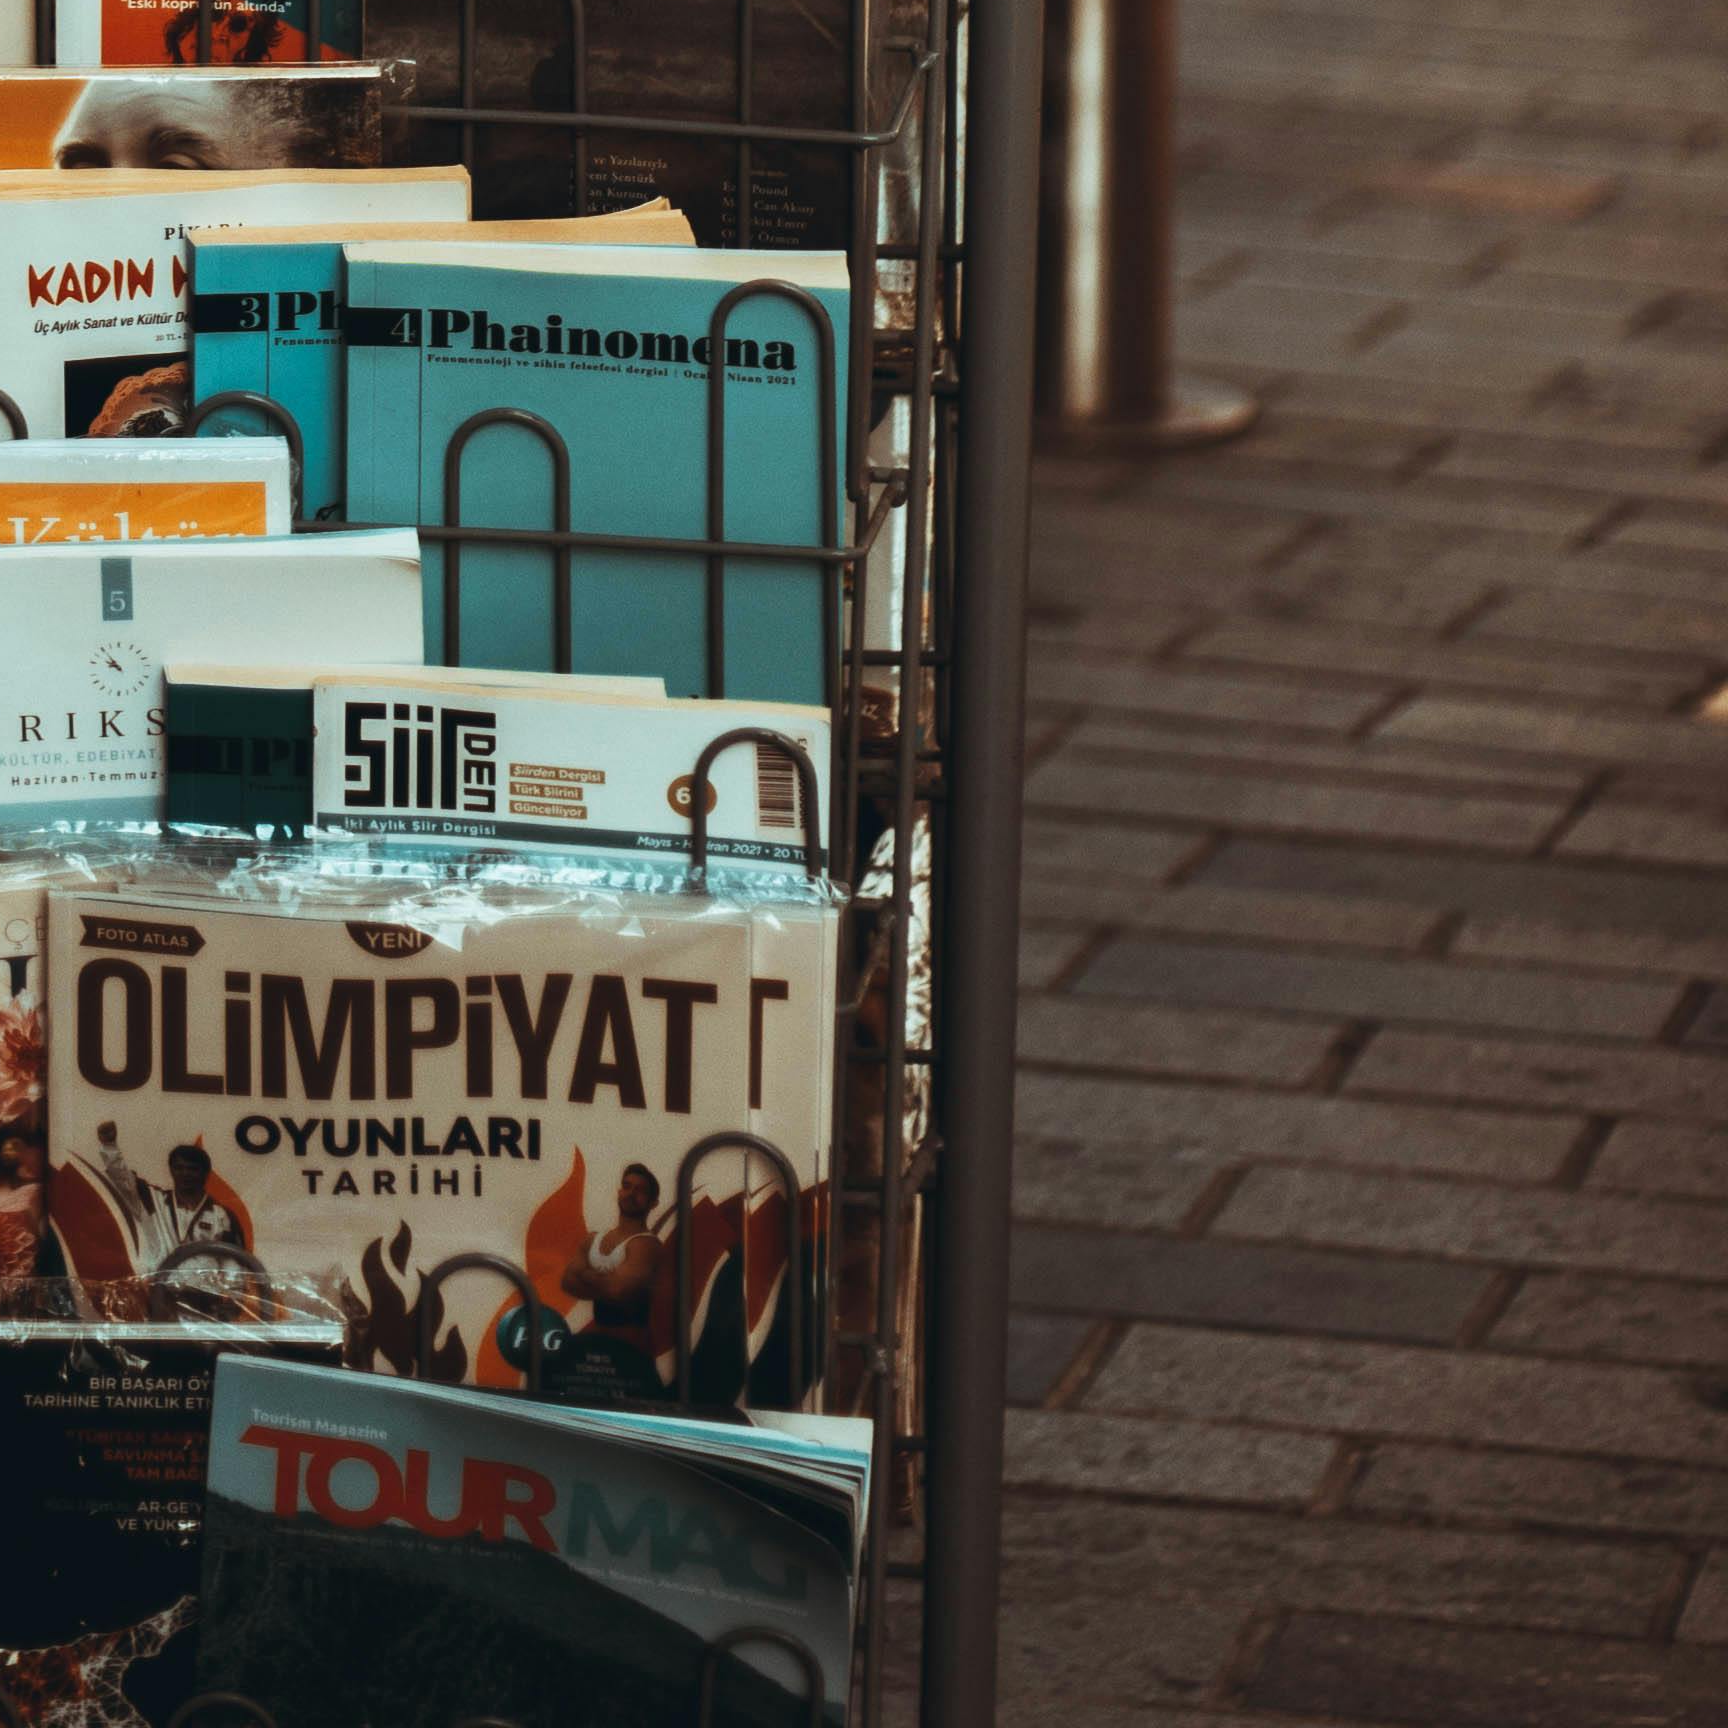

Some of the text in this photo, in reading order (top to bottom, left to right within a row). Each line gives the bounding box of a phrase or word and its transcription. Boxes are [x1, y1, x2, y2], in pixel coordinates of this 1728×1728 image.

[28, 255, 155, 309] KADIN
[34, 311, 174, 336] Üç Aylık Sanat Kültür
[239, 296, 263, 331] 3
[389, 307, 798, 373] 4 Phainomena
[427, 353, 797, 386] Fenomenoloji 2021
[108, 589, 125, 613] 5
[513, 764, 603, 784] Şiirden Dergisi
[515, 785, 542, 797] Türk
[369, 819, 497, 838] Aylık Dergisi
[732, 845, 764, 858] 2021
[97, 927, 423, 950] FOTO ATLAS YENİ
[233, 1114, 543, 1163] OYUNLARI
[301, 1164, 484, 1200] TARİHİ
[89, 1375, 183, 1392] BİR BAŞARI
[24, 1392, 180, 1409] TARİHİNE TANIKLIK
[252, 1406, 388, 1443] Tourism Magazine
[239, 1424, 560, 1554] TOUR
